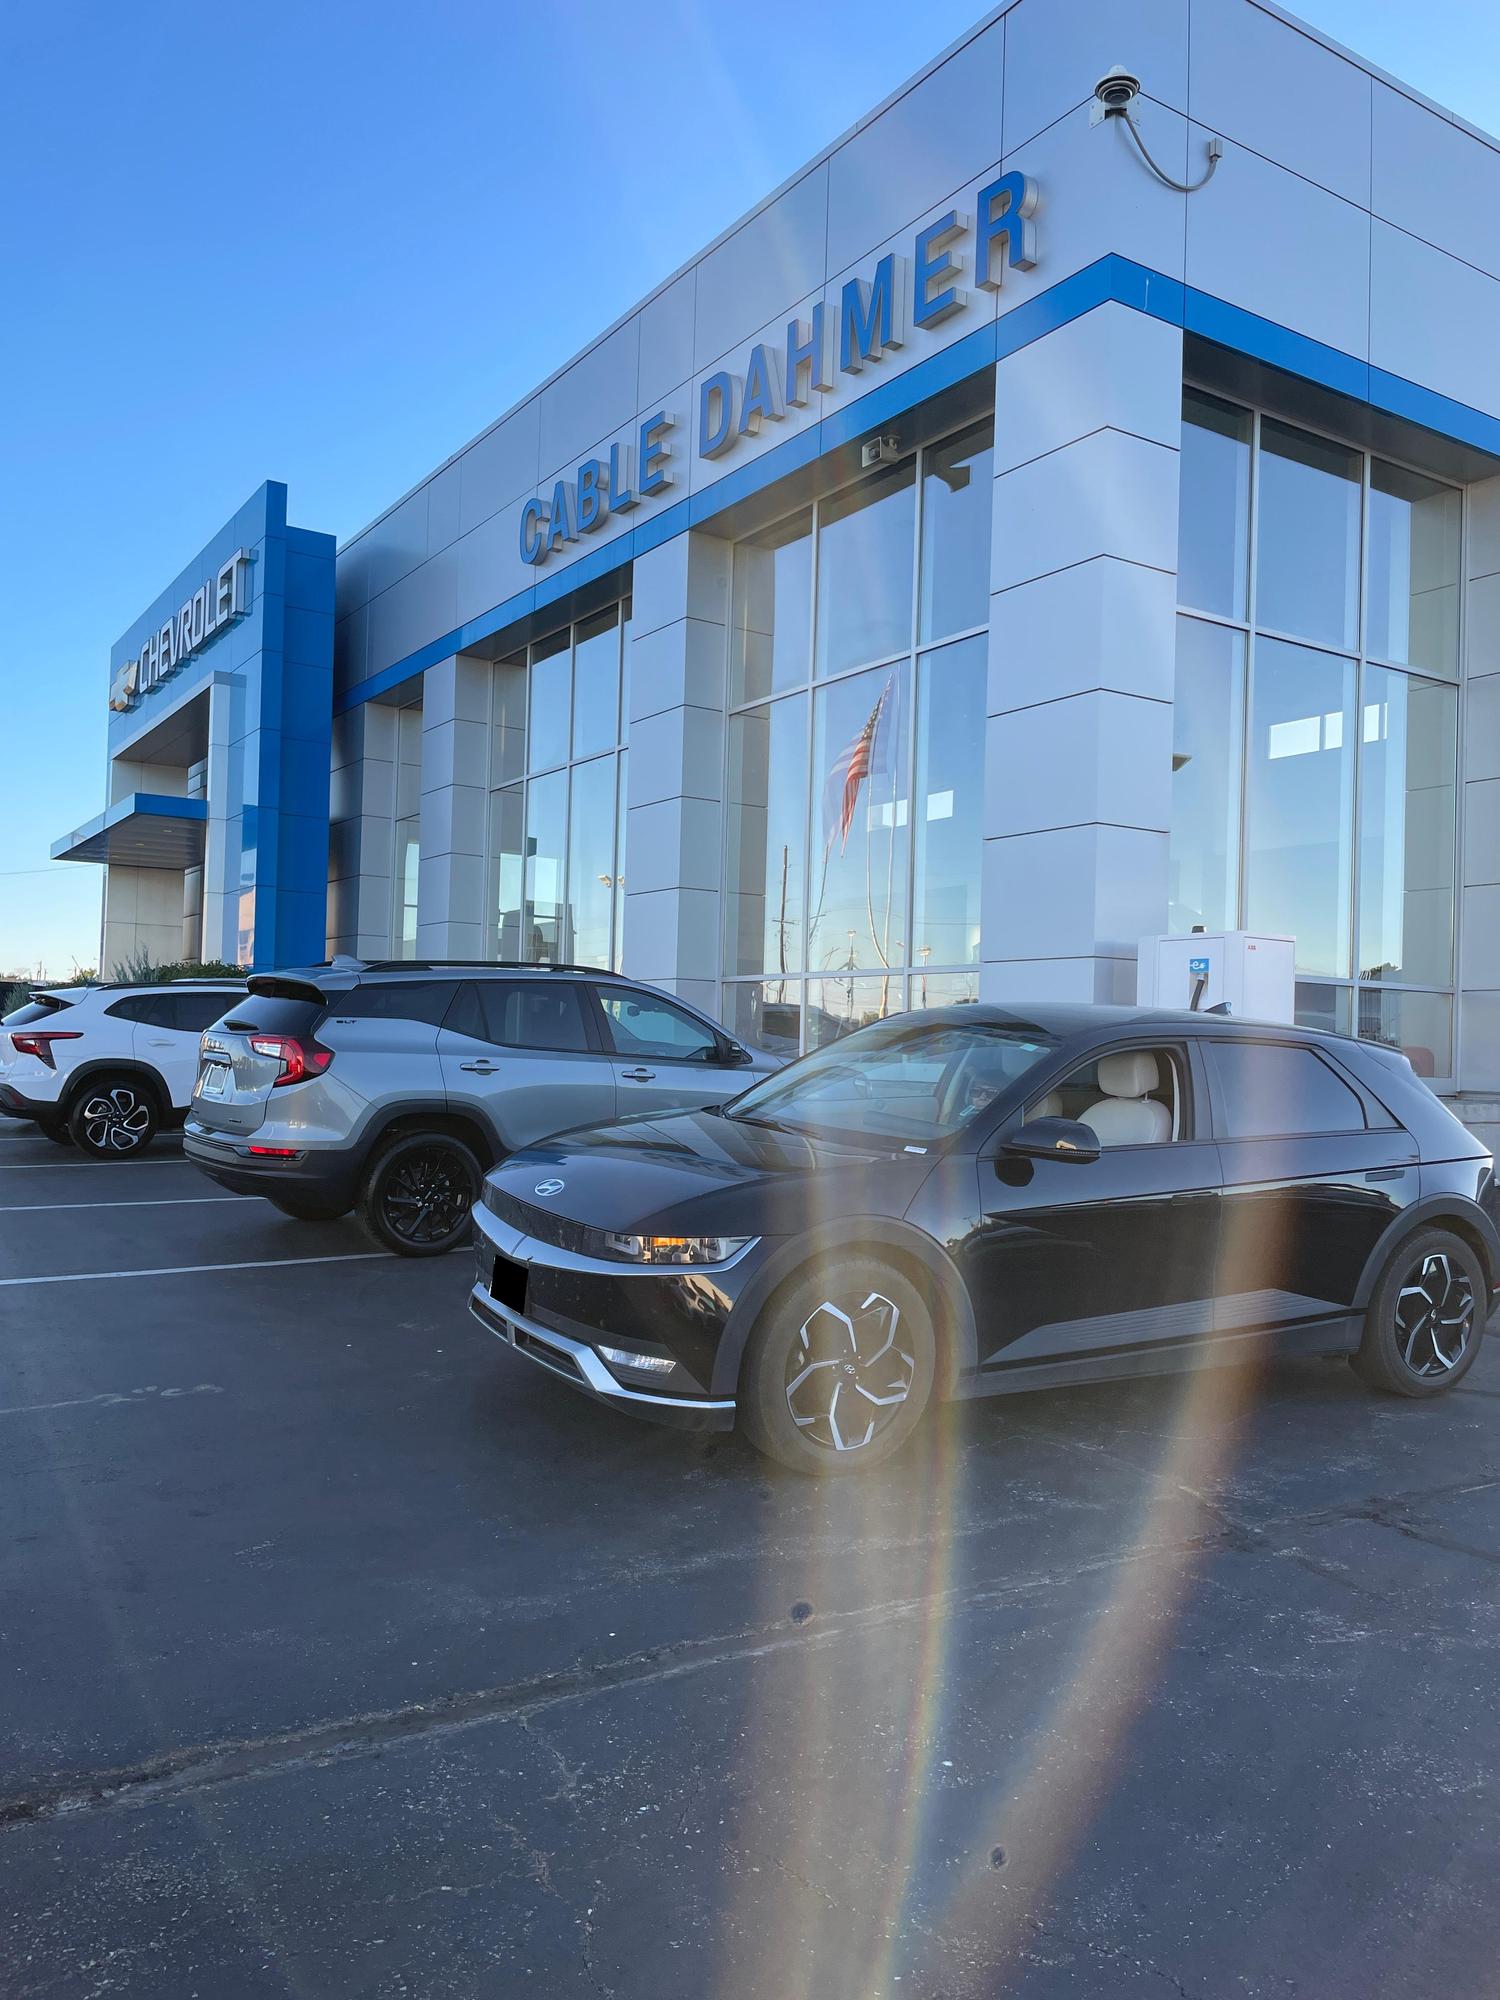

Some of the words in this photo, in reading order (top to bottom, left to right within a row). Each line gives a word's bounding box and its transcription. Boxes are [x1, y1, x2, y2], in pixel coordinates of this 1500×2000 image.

[519, 410, 675, 566] CABLE
[699, 170, 1038, 460] DAHMER
[139, 547, 249, 694] CHEVROLET
